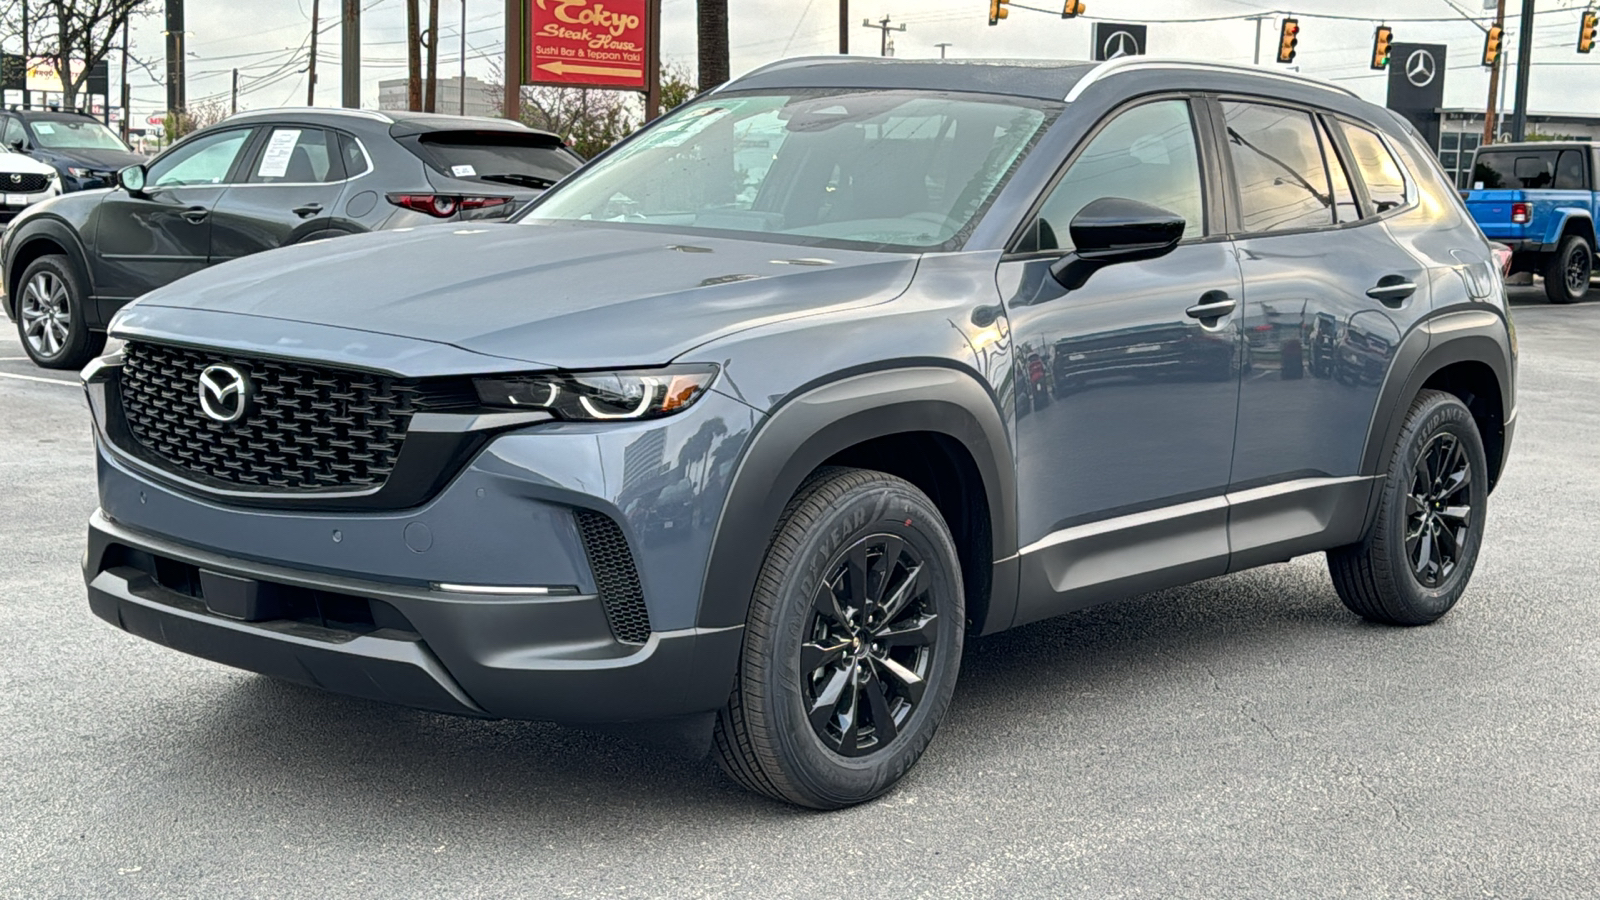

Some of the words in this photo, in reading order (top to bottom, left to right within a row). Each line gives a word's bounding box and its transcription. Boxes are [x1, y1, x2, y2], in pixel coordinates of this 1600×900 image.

[536, 0, 639, 36] Tokyo
[535, 24, 592, 40] Steak
[588, 34, 643, 52] House
[536, 45, 559, 55] Sushi
[560, 47, 576, 57] Bar
[577, 49, 585, 57] &
[587, 49, 621, 61] Teppan
[622, 52, 640, 62] Yaki
